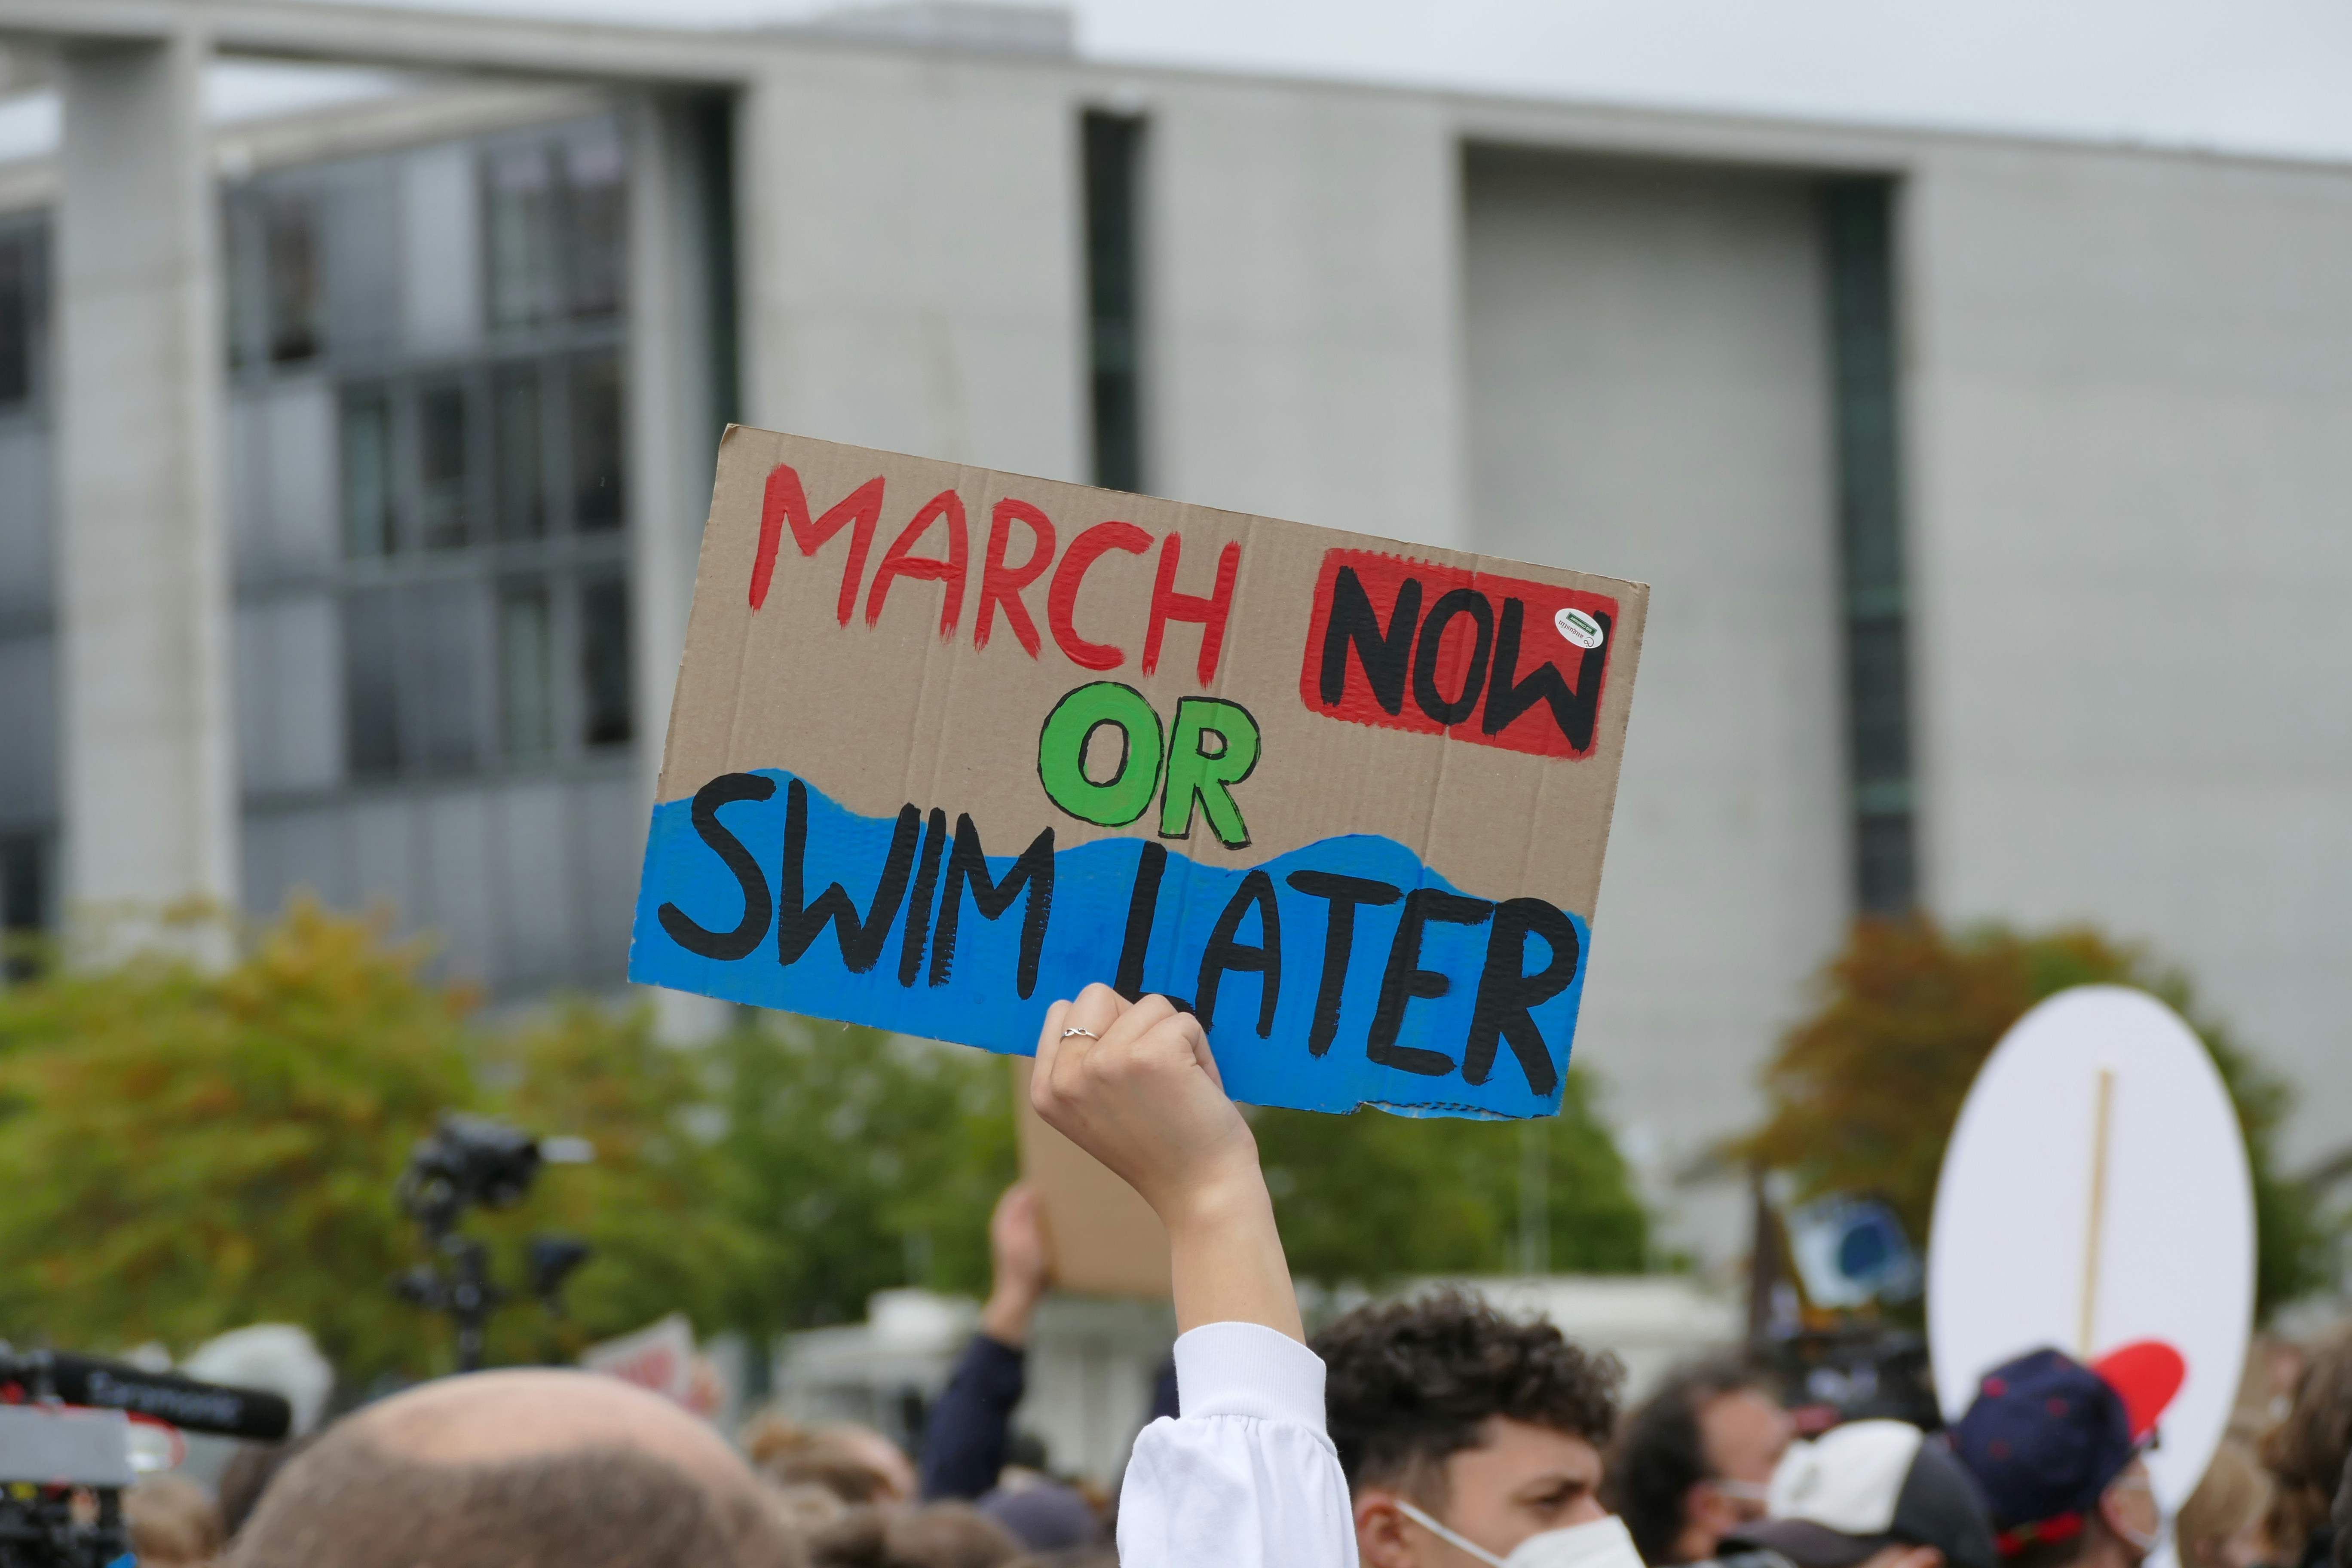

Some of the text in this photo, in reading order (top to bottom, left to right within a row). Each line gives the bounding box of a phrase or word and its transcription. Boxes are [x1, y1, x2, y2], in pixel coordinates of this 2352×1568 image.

[749, 464, 1611, 753] MARCH NOW
[1559, 620, 1584, 639] augustin
[1037, 680, 1261, 850] OR
[658, 773, 1579, 1096] SWIM LATER
